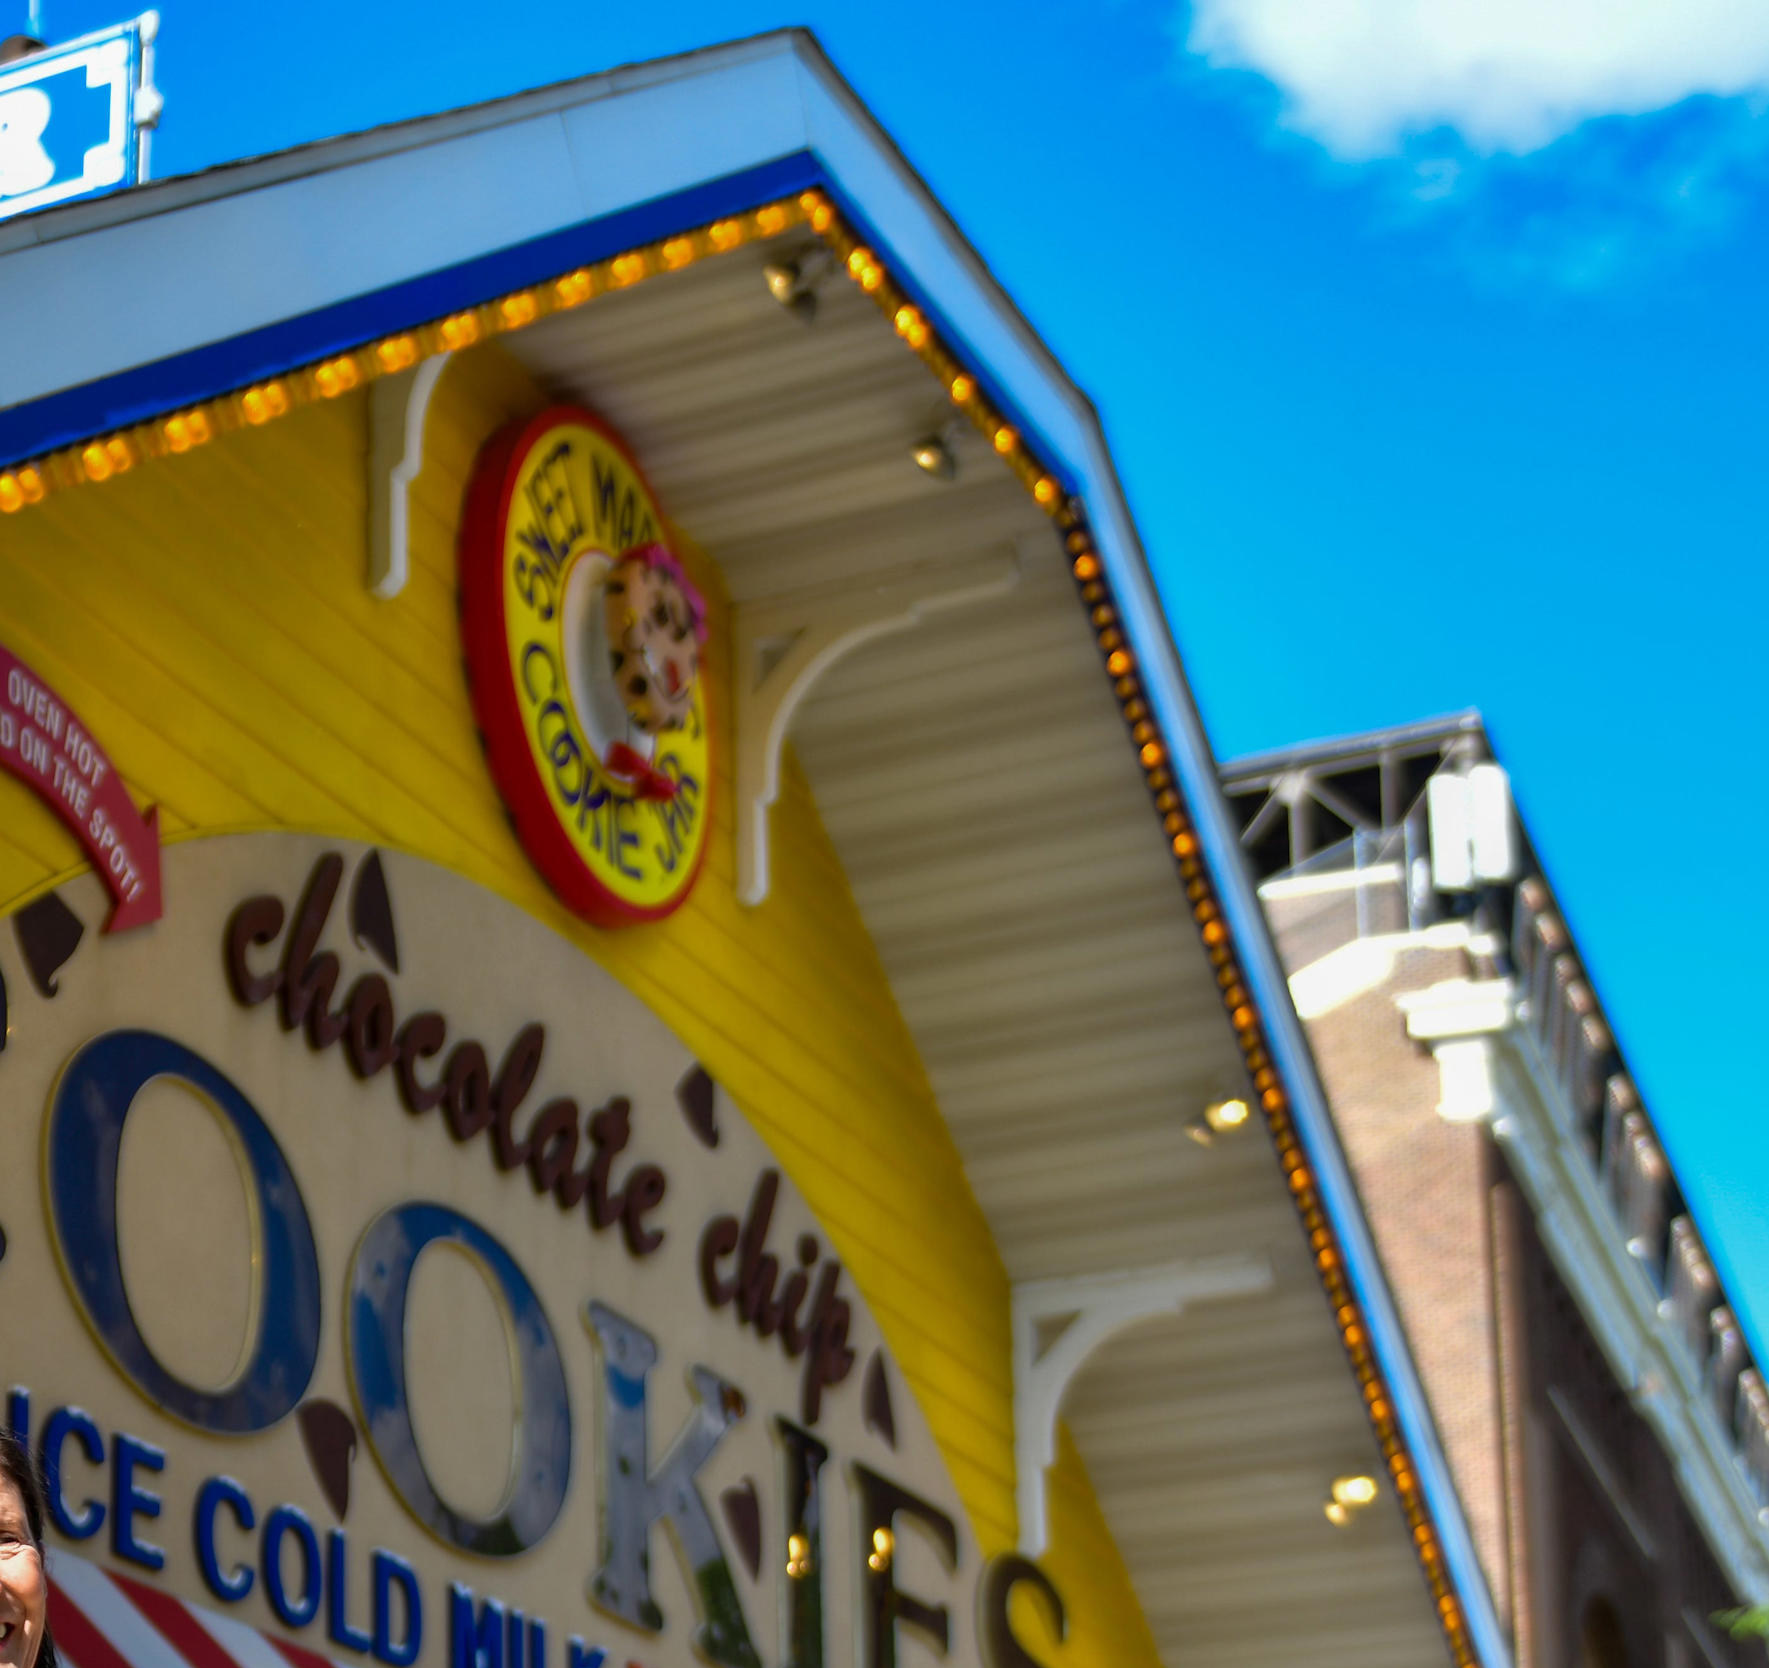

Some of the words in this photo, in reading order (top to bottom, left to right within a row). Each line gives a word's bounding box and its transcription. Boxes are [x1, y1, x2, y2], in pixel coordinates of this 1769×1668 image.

[514, 441, 585, 621] SWEET
[8, 668, 62, 741] OVEN
[64, 721, 106, 788] HOT
[19, 726, 50, 775] ON
[52, 754, 90, 820] THE
[88, 807, 143, 903] SPOT!
[522, 644, 644, 881] COOKIE
[222, 850, 667, 1257] chocolate
[698, 1168, 857, 1426] chip
[6, 1385, 166, 1571] ICE
[194, 1475, 423, 1668] COLD
